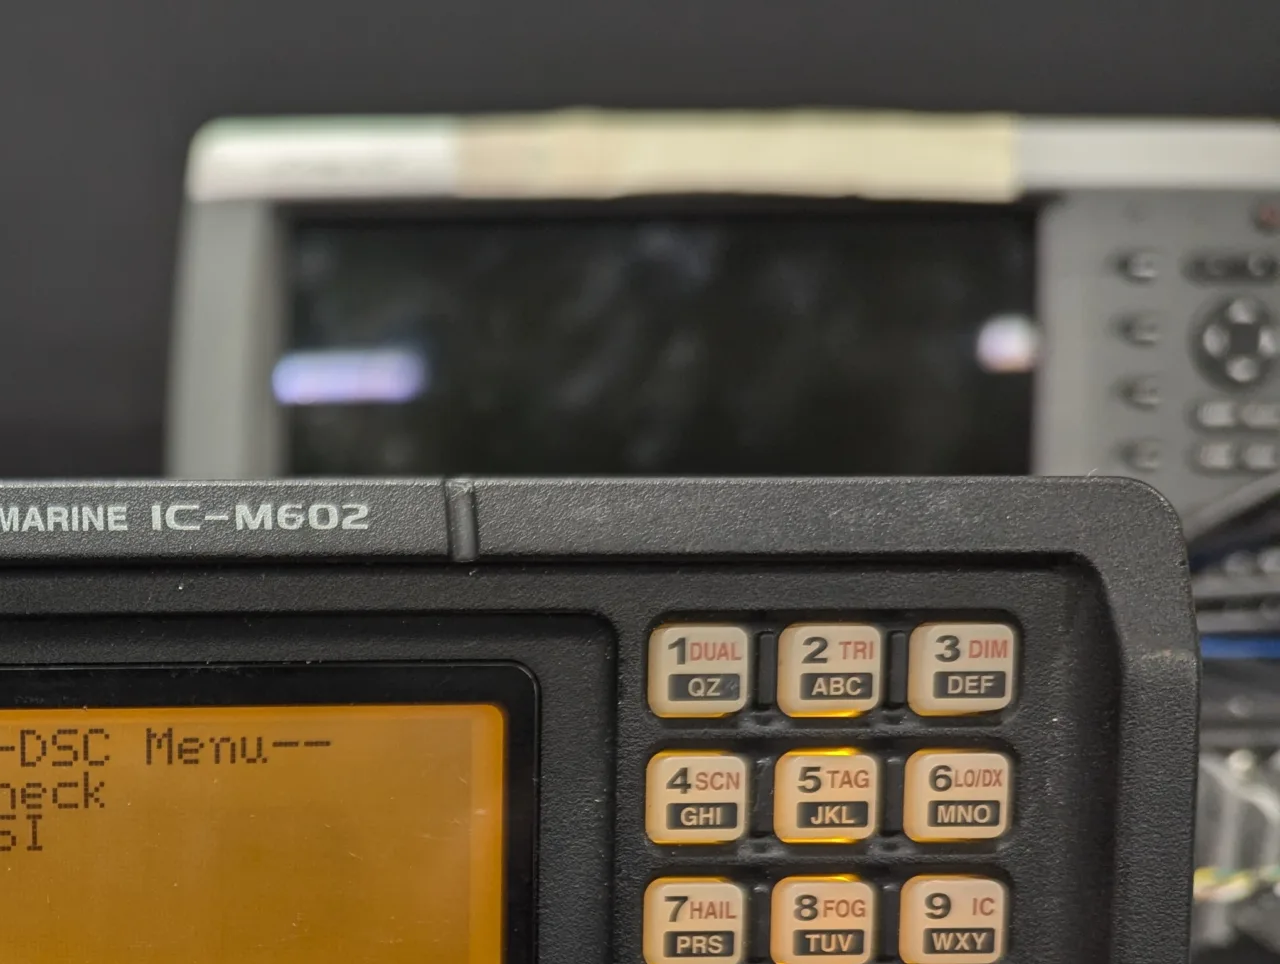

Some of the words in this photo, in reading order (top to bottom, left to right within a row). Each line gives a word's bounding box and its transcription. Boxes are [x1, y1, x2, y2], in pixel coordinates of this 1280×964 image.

[151, 503, 369, 532] IC-M602
[667, 637, 687, 665] 1
[689, 641, 742, 662] DUAL
[801, 636, 829, 665] 2
[839, 640, 875, 660] TRI
[934, 634, 961, 663] 3
[968, 639, 1008, 660] DIM
[687, 678, 721, 697] QZ
[811, 677, 862, 696] ABC
[947, 675, 995, 695] DEF
[666, 766, 692, 794] 4
[694, 771, 740, 791] SCN
[797, 766, 822, 794] 5
[826, 769, 870, 789] TAG
[928, 764, 952, 792] 6
[954, 768, 1003, 789] LO/DX
[680, 807, 722, 826] GHI
[810, 806, 855, 825] JKL
[937, 804, 991, 823] MNO
[664, 895, 689, 923] 7
[689, 901, 737, 920] HAIL
[793, 894, 818, 921] 8
[822, 899, 867, 918] FOG
[924, 892, 951, 920] 9
[972, 897, 996, 917] IC
[676, 935, 724, 954] PRS
[805, 933, 854, 953] TUV
[931, 932, 988, 951] WXY
